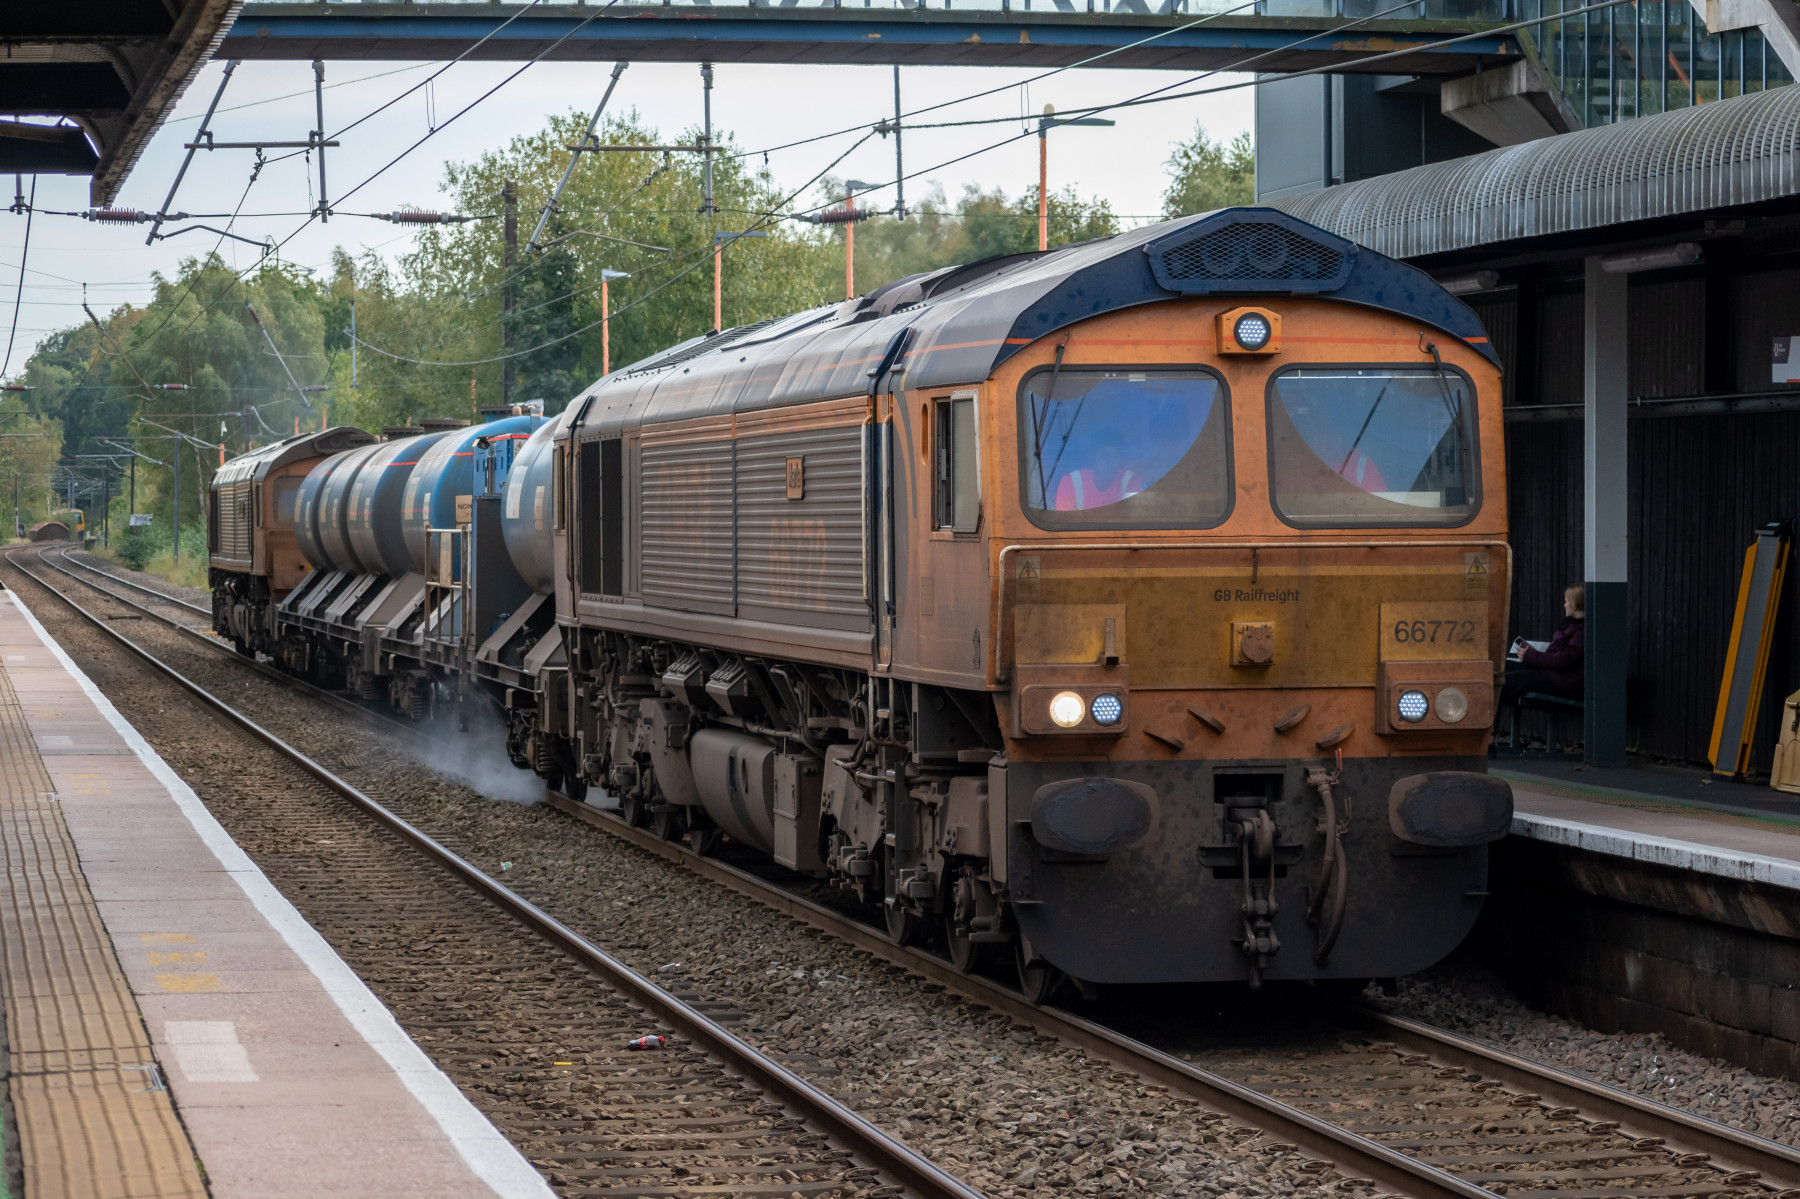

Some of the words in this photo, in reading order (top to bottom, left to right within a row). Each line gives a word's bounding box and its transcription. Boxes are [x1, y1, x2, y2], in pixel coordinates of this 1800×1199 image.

[1213, 589, 1231, 602] GB
[1234, 588, 1300, 605] Railfreight
[1394, 619, 1476, 643] 66772
